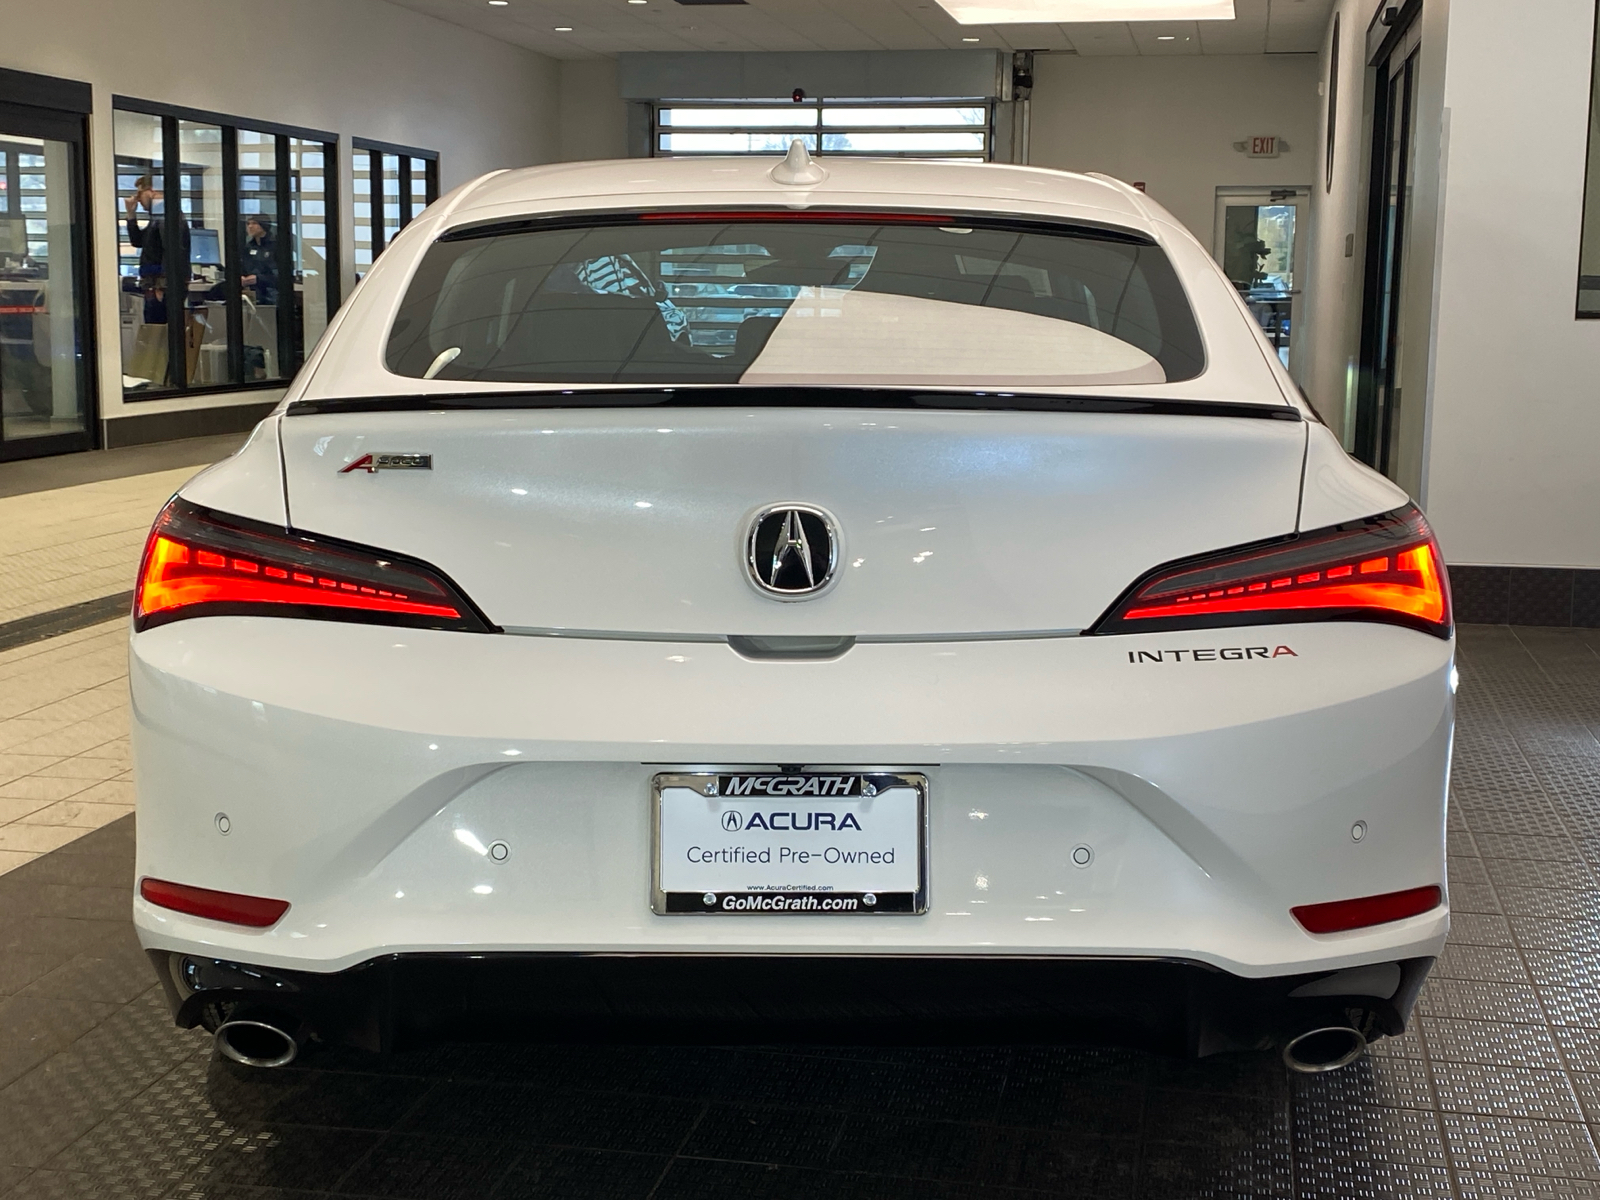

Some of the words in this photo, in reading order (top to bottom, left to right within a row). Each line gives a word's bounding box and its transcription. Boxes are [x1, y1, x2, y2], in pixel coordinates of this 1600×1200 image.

[1252, 136, 1275, 154] EXIT
[1127, 645, 1299, 664] INTEGRA
[744, 812, 862, 831] ACURA
[686, 846, 771, 864] Certified
[779, 847, 895, 864] Pre-Owned
[746, 884, 834, 892] www.AcuraCertified.com
[721, 895, 858, 911] GoMcGrath.com
